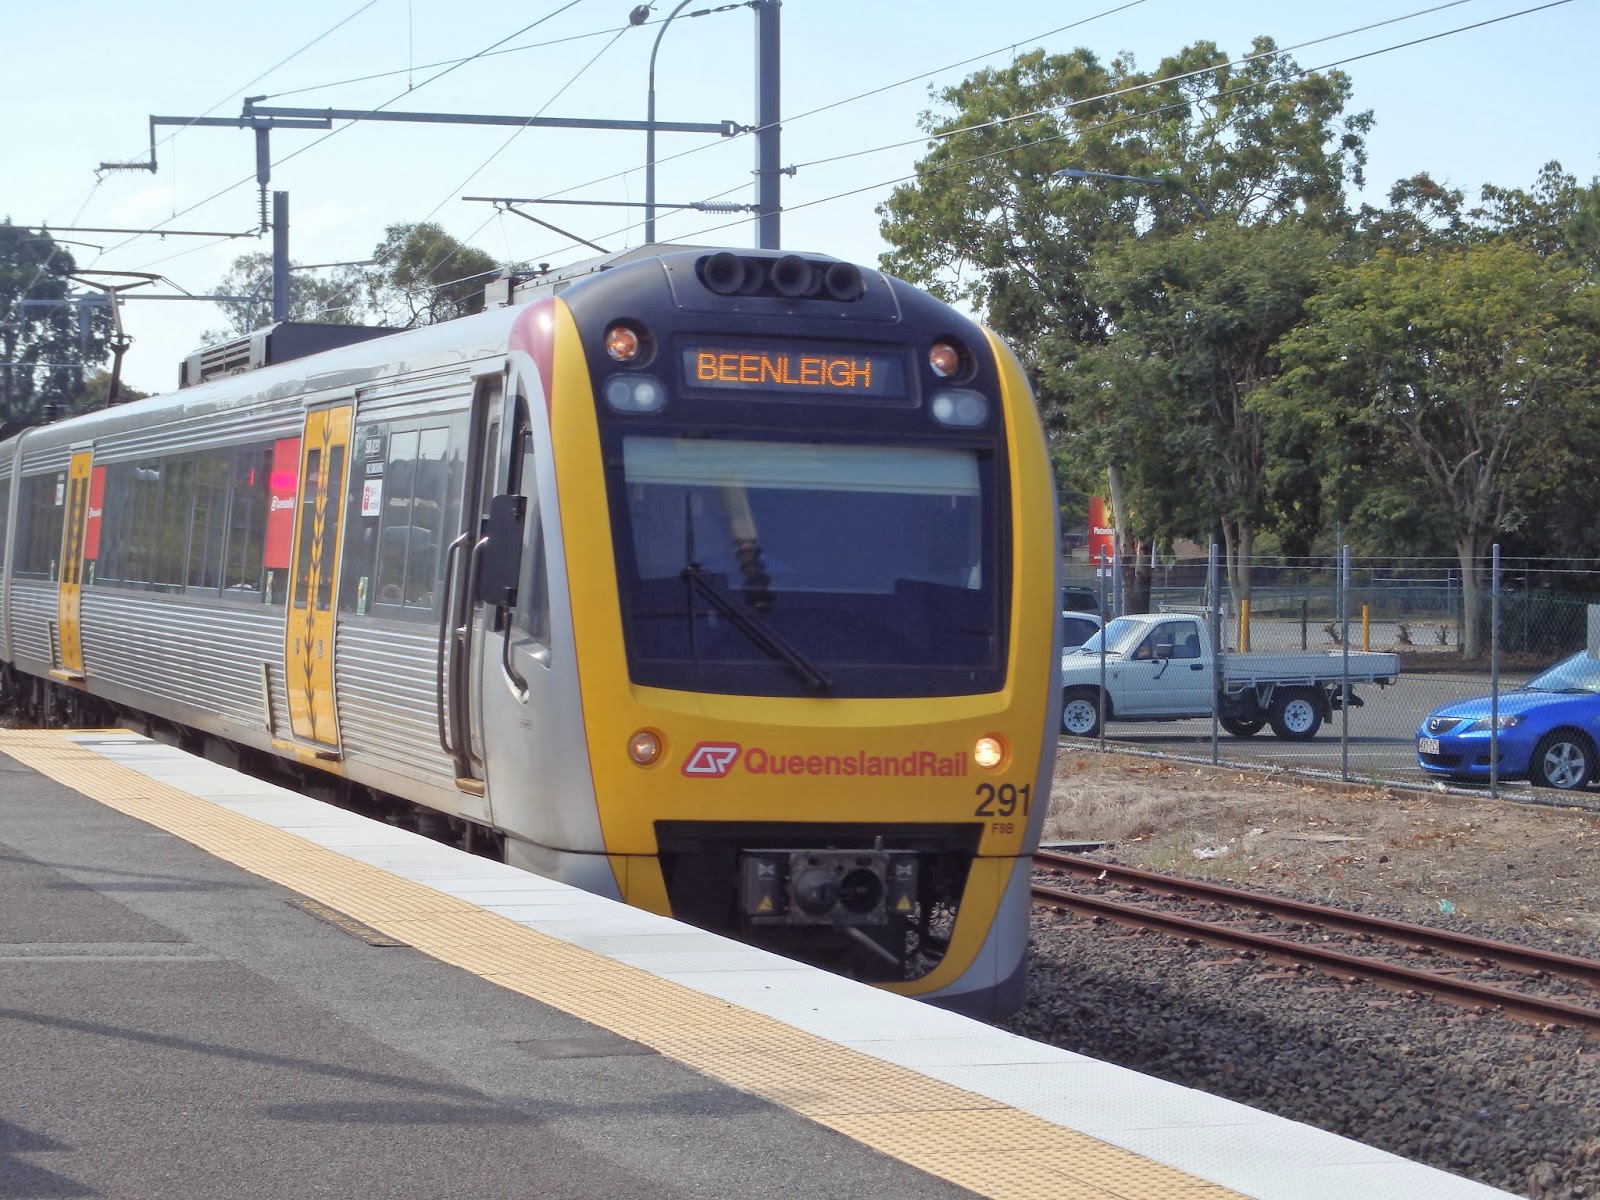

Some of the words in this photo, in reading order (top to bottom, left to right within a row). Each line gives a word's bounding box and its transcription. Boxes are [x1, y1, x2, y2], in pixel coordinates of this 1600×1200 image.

[697, 352, 871, 388] BEENLEIGH
[744, 748, 968, 777] QueenslandRail
[974, 783, 1031, 817] 291
